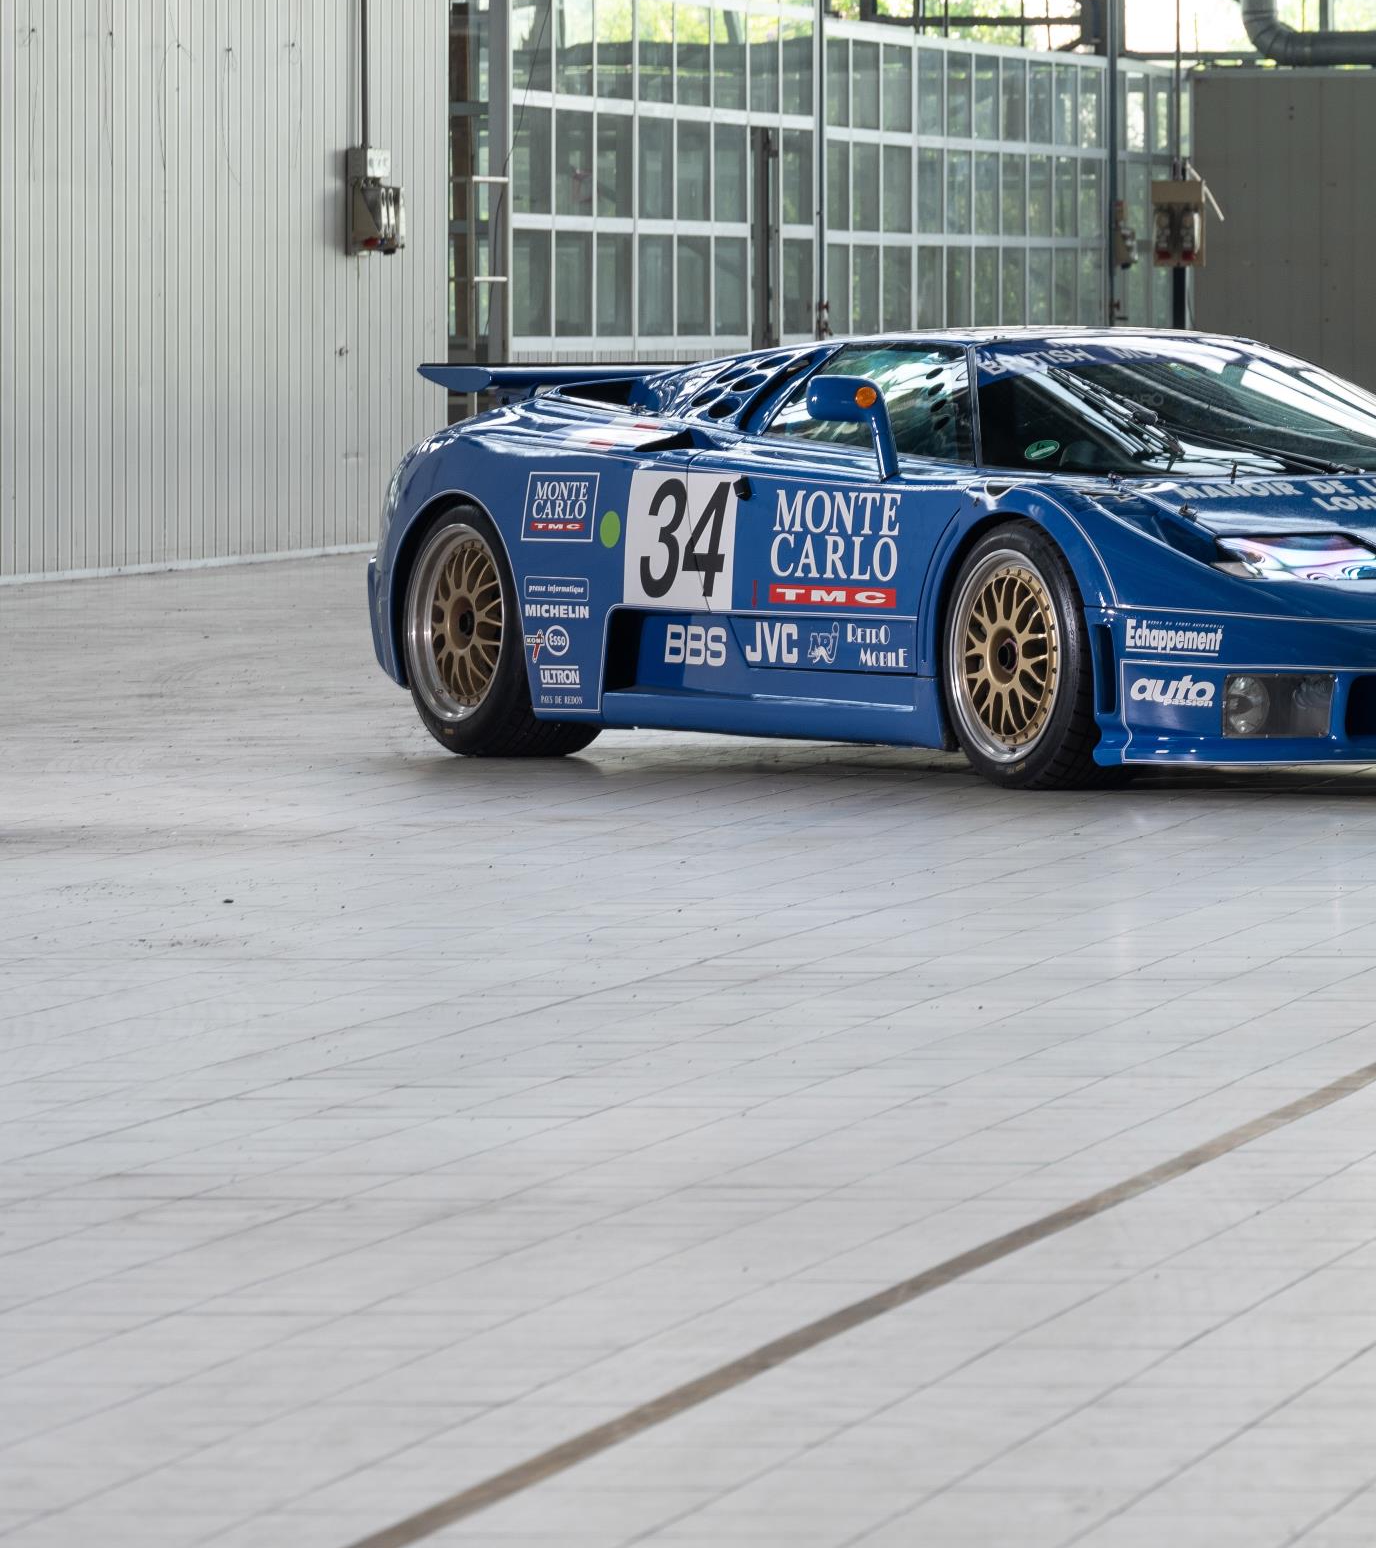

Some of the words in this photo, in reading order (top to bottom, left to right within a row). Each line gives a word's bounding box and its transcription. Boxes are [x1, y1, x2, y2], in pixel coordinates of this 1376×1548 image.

[535, 481, 589, 500] MONTE
[1173, 481, 1304, 499] MANOIR
[1307, 479, 1355, 494] DE
[532, 499, 586, 519] CARLO
[773, 489, 901, 536] MONTE
[639, 477, 732, 599] 34
[770, 533, 898, 582] CARLO
[776, 588, 887, 604] TMC
[525, 604, 590, 619] MICHELIN
[664, 623, 727, 667] BBS
[746, 621, 798, 664] JVC
[1126, 618, 1223, 653] Echappement
[540, 670, 580, 684] ULTRON
[1130, 675, 1216, 703] auto
[555, 695, 563, 704] DE
[1163, 698, 1213, 707] passion
